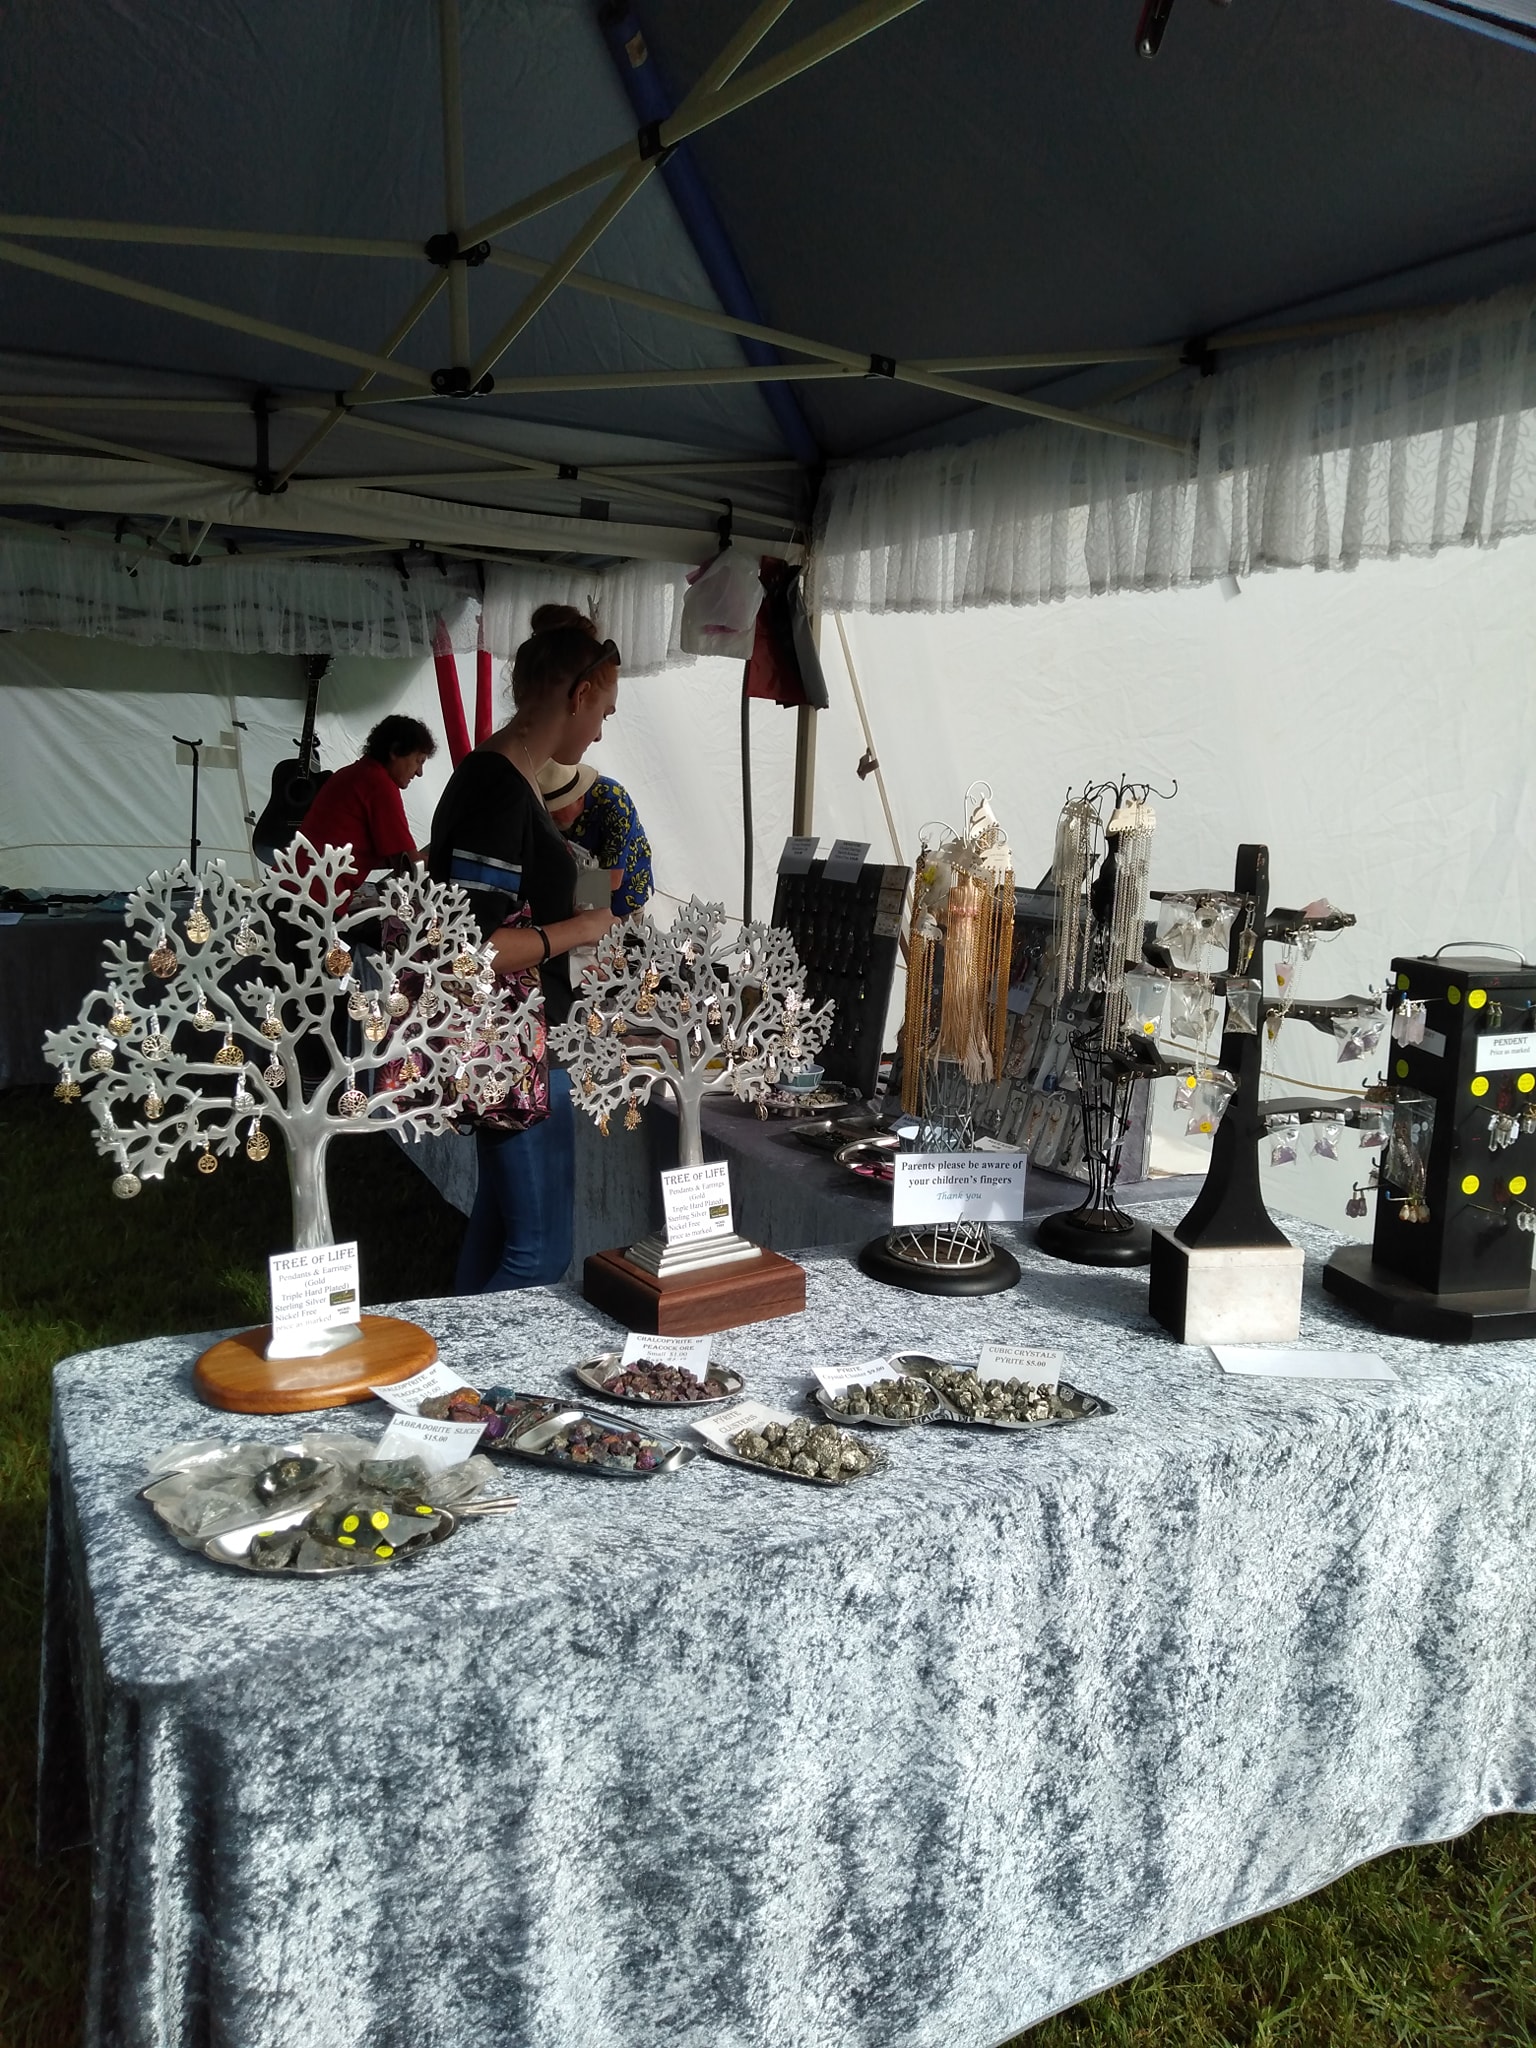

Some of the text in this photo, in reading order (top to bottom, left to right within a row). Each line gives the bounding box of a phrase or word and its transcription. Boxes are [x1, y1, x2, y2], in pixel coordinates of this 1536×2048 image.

[1494, 1037, 1528, 1046] PENDENT
[902, 1162, 935, 1170] Parents
[938, 1161, 965, 1171] please
[969, 1161, 979, 1169] be
[1013, 1161, 1023, 1169] of
[664, 1173, 690, 1185] TREE
[706, 1168, 725, 1178] LIFE
[909, 1179, 929, 1187] your
[980, 1175, 1011, 1185] fingers
[669, 1186, 694, 1195] Pendants
[937, 1192, 981, 1201] Thank you
[669, 1223, 686, 1231] Nickel
[692, 1227, 712, 1236] marked
[273, 1248, 355, 1271] TREE OF LIFE
[279, 1271, 311, 1282] Pendants
[323, 1264, 352, 1274] Earrings
[305, 1278, 325, 1288] (Gold
[282, 1283, 349, 1301] Triple Hard Plated)
[275, 1303, 303, 1312] Sterling
[306, 1298, 326, 1306] Silver
[275, 1309, 317, 1321] Nickel Free
[306, 1315, 331, 1325] marked
[1015, 1350, 1056, 1359] CRYSTALS
[995, 1357, 1024, 1365] PYRITE
[378, 1375, 427, 1392] CHALCOPYRITE
[392, 1379, 438, 1398] PEACOCK ORE
[419, 1386, 441, 1398] $15.00
[713, 1410, 742, 1424] PYRITE
[393, 1419, 451, 1433] LABRADORITE
[719, 1415, 758, 1433] CLUSTERS
[423, 1434, 448, 1442] $15.00
